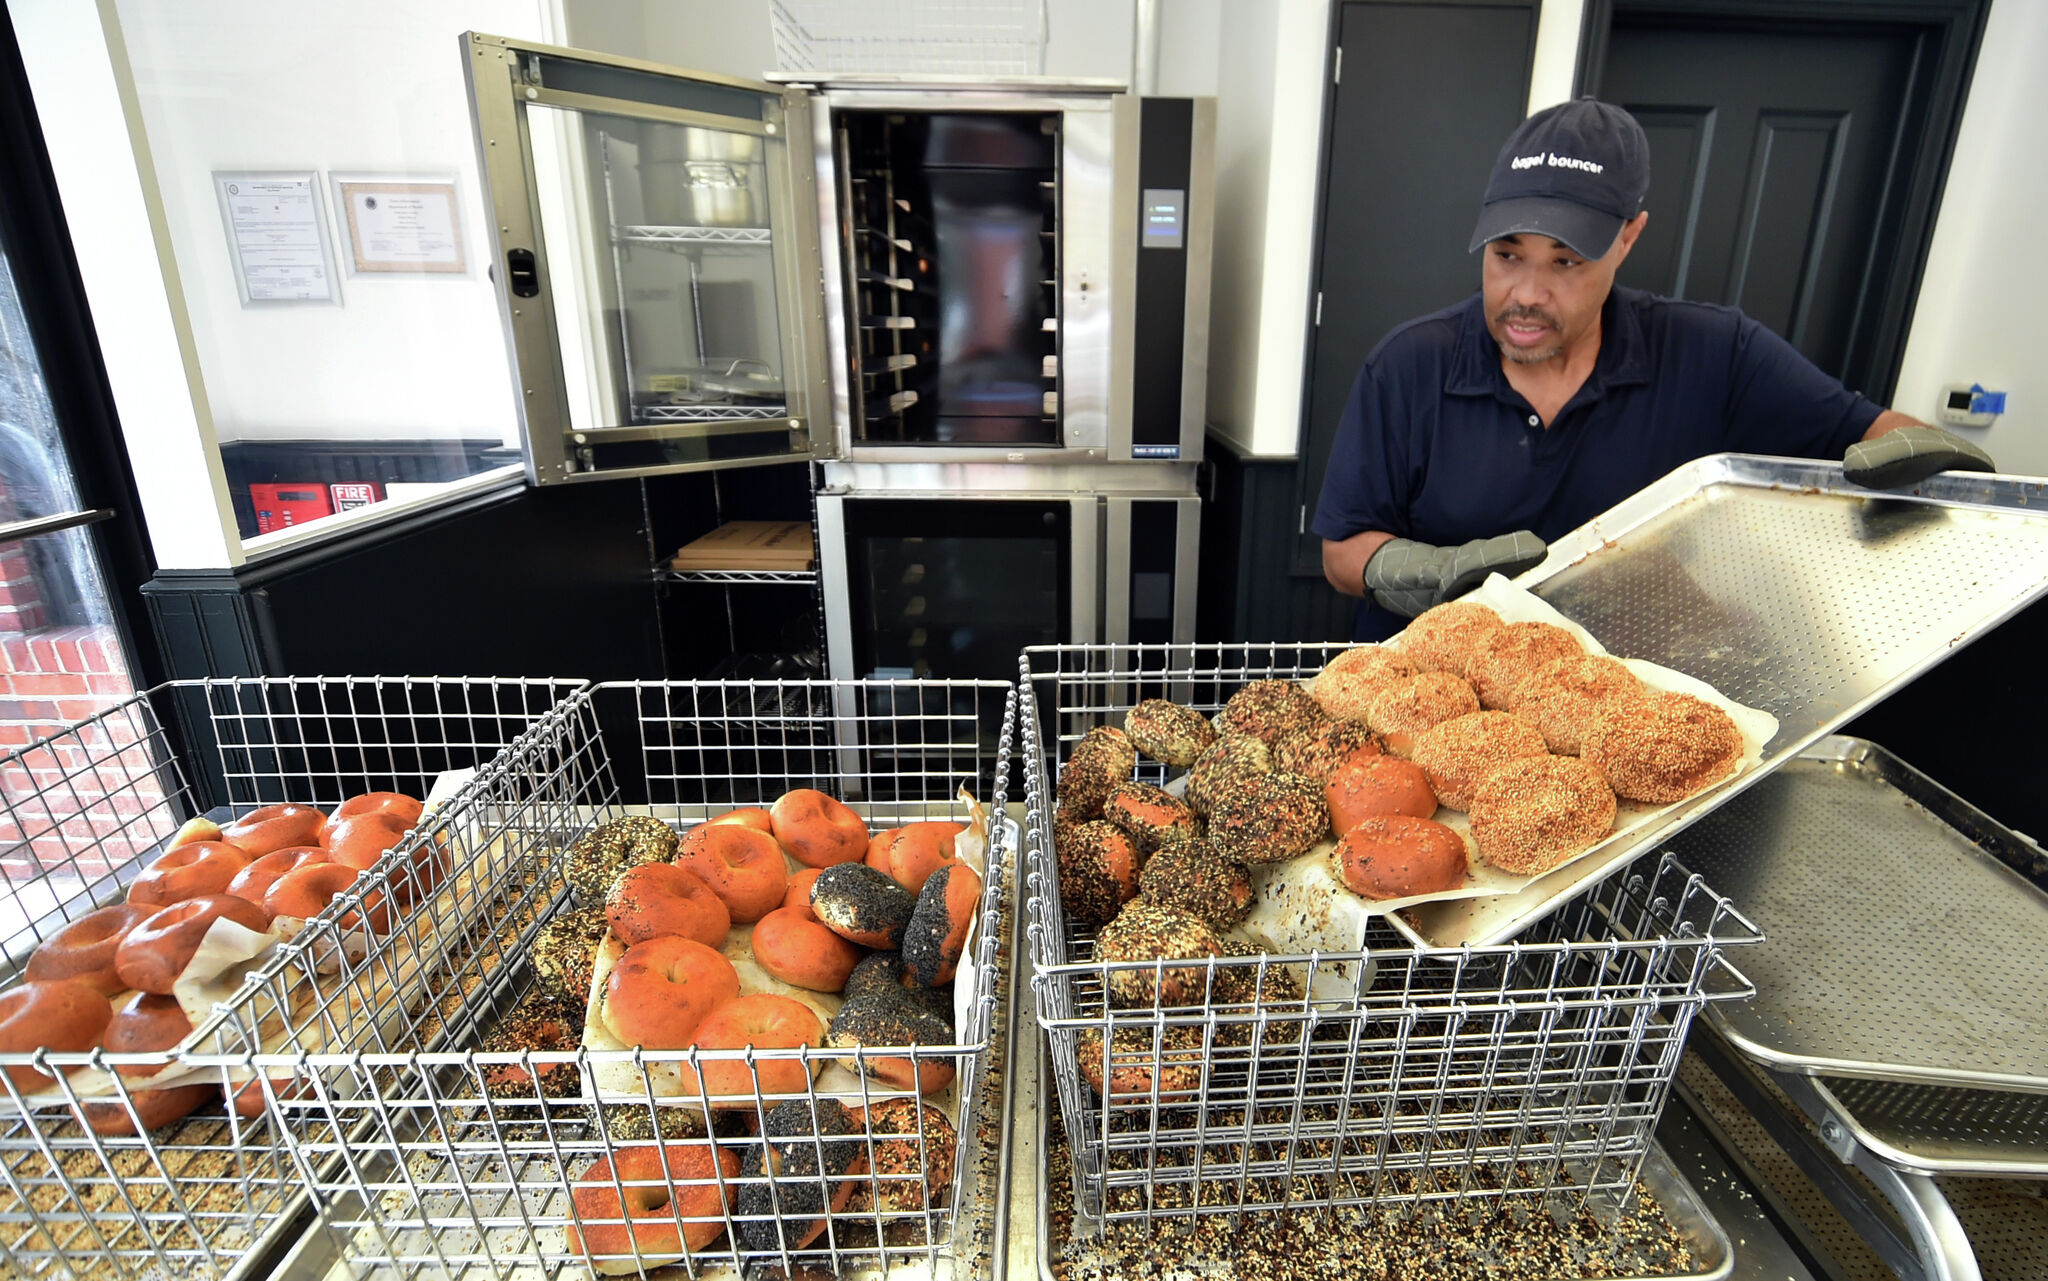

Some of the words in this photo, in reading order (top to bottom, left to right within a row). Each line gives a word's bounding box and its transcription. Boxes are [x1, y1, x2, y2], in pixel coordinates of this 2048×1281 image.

[1511, 152, 1545, 170] bagel
[1548, 152, 1603, 173] bouncer
[335, 486, 369, 499] FIRE
